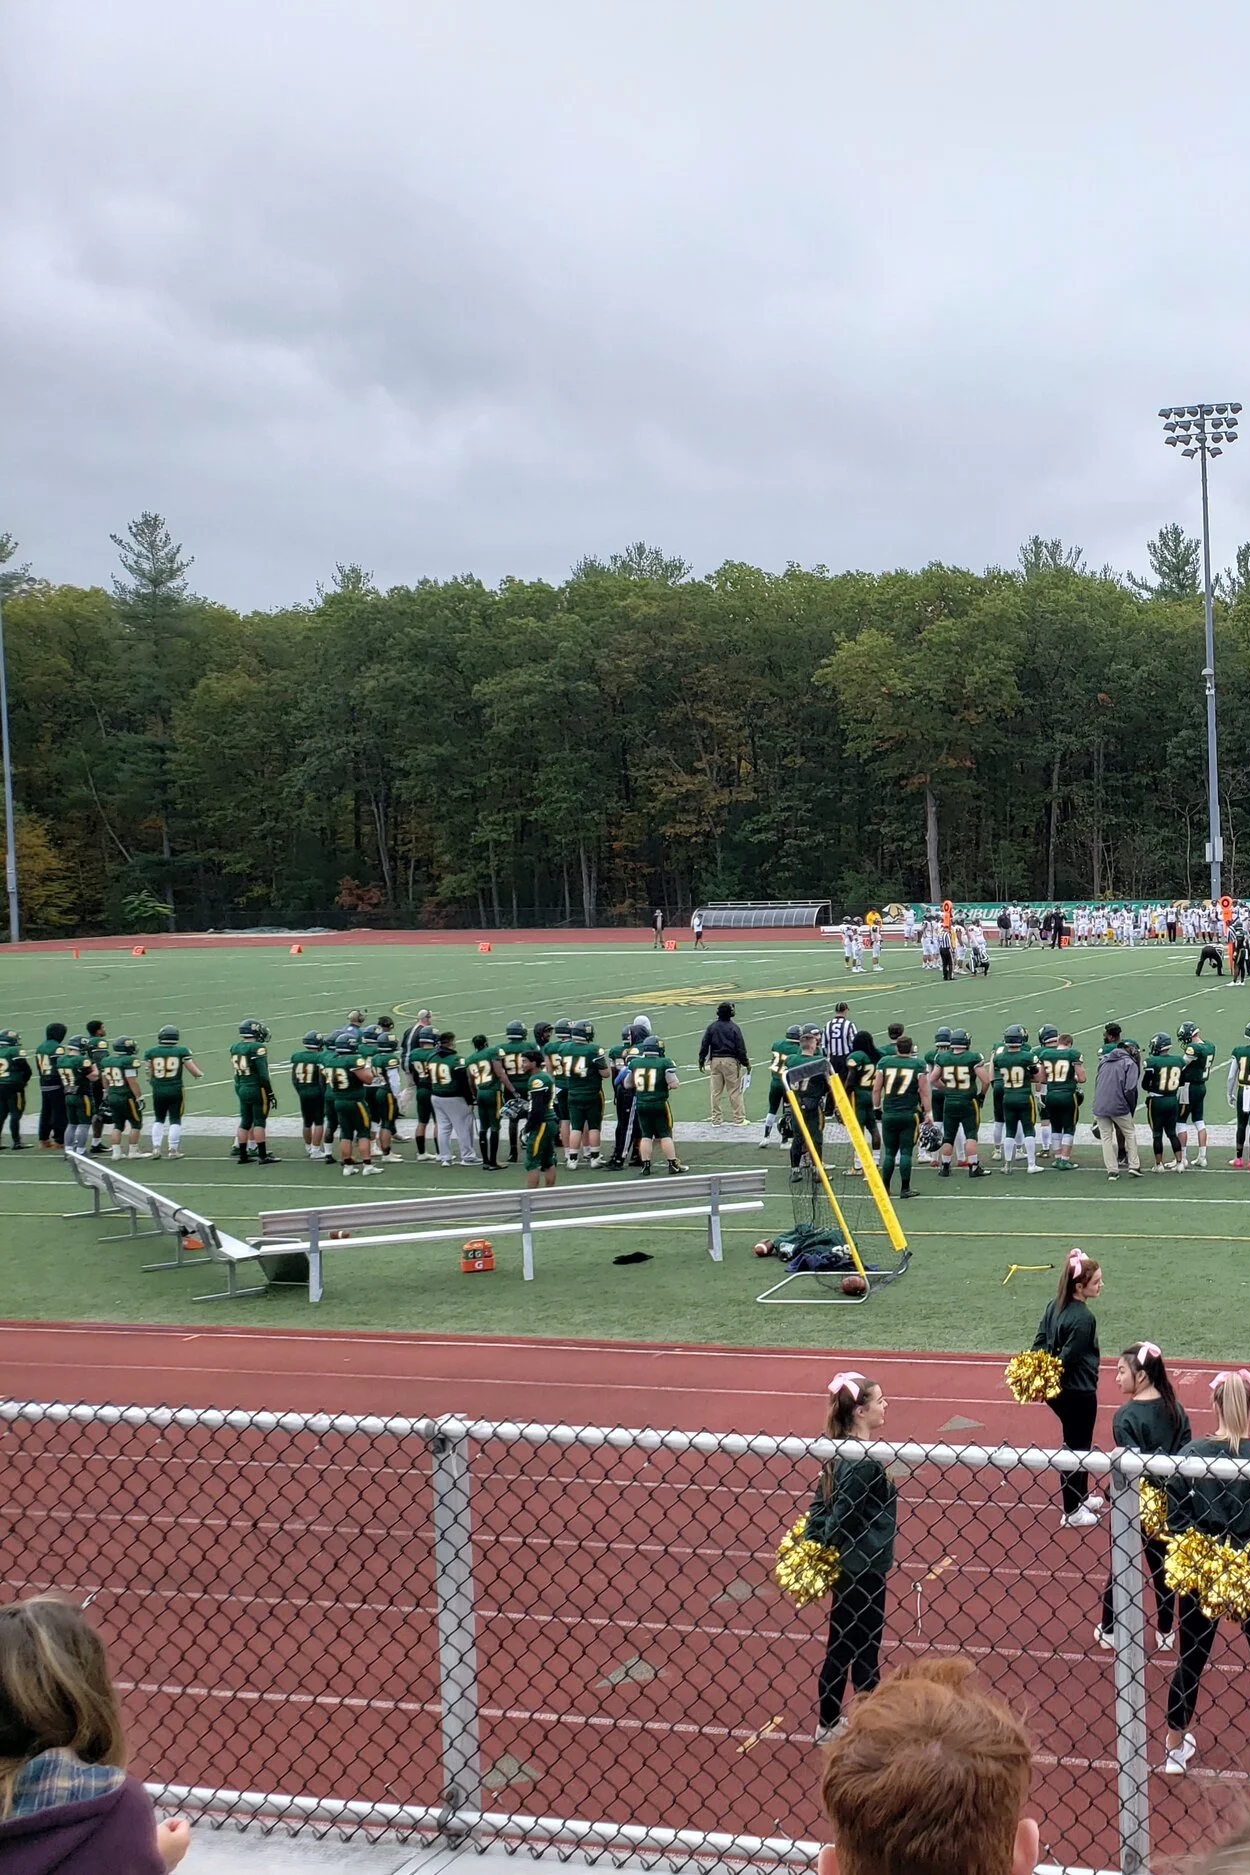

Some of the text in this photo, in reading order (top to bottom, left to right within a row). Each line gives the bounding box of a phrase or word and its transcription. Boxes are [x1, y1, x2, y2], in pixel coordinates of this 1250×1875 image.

[831, 1023, 841, 1038] S
[153, 1056, 179, 1078] 89
[295, 1062, 314, 1084] 41
[943, 1066, 971, 1090] 55
[1159, 1066, 1181, 1091] 18
[885, 1067, 914, 1095] 77
